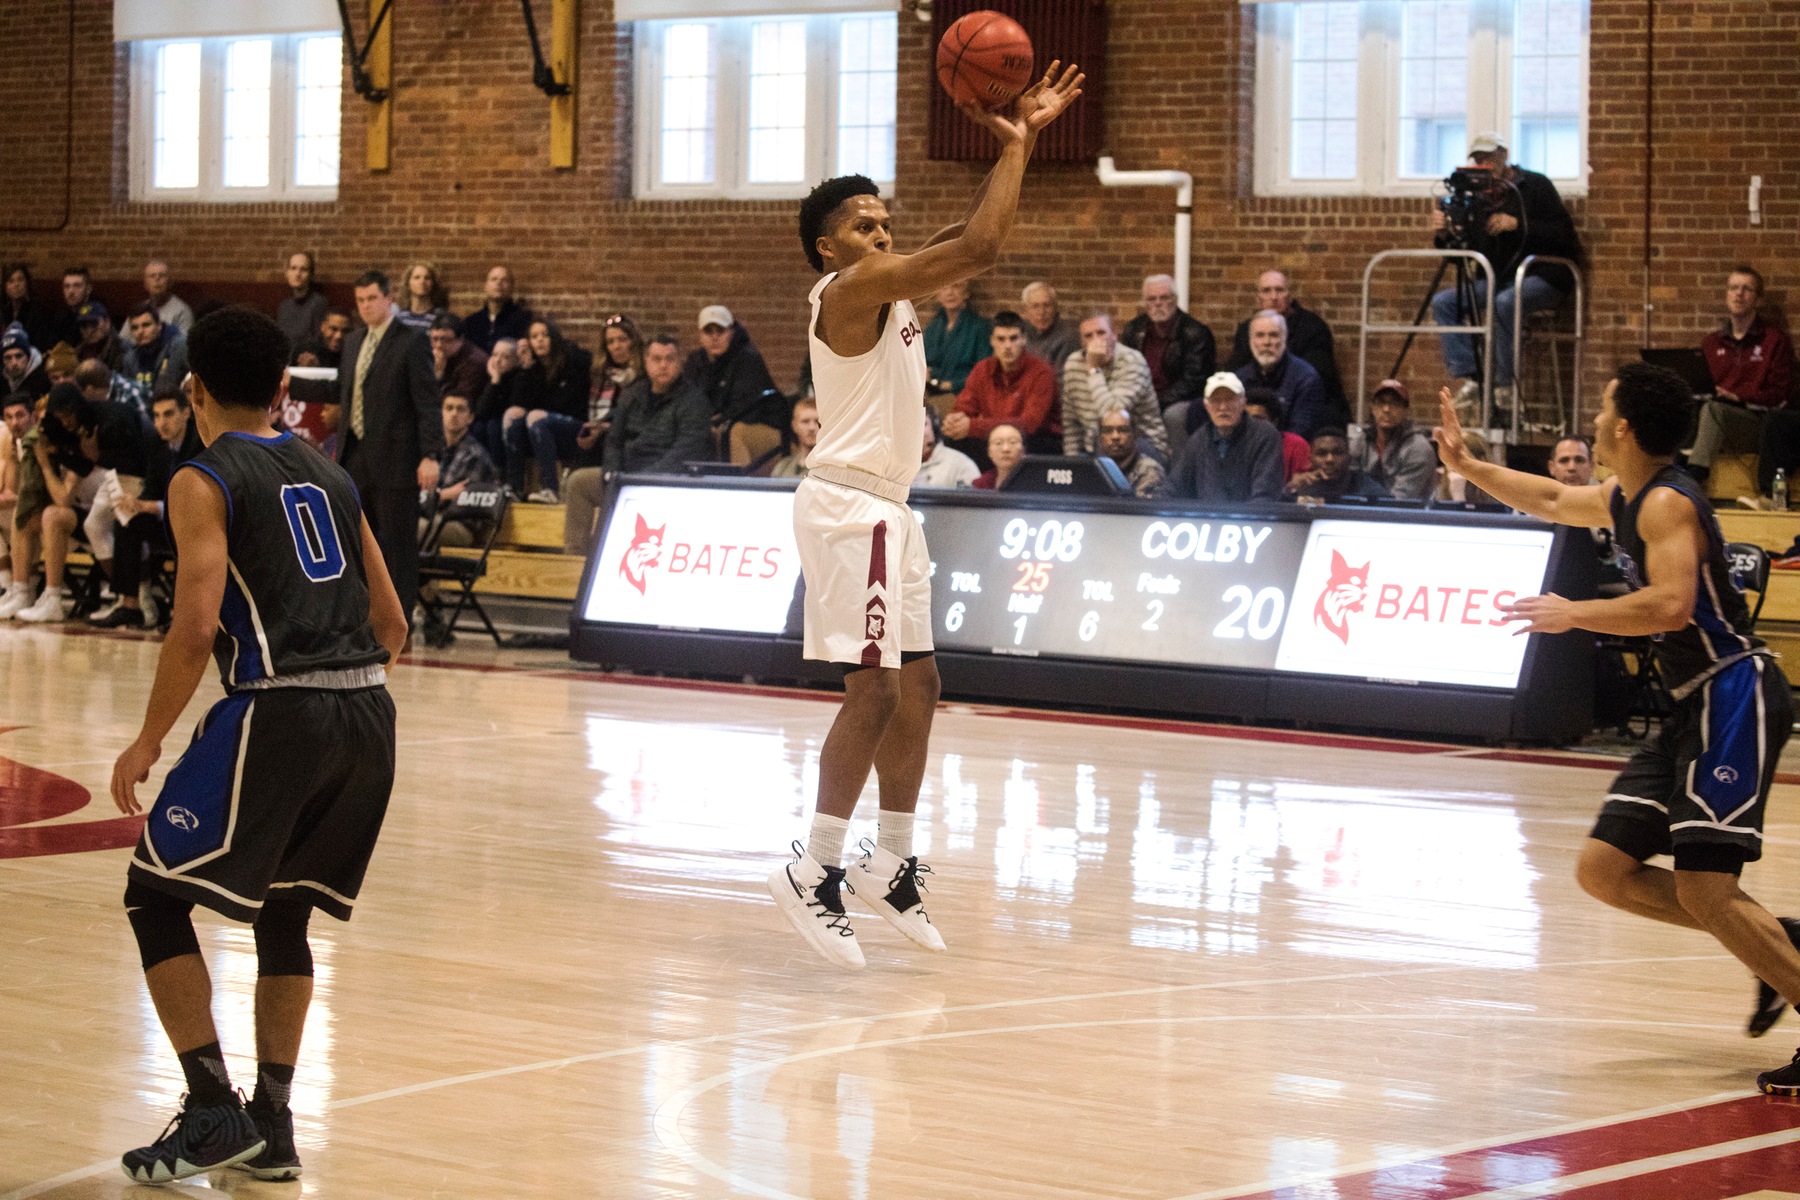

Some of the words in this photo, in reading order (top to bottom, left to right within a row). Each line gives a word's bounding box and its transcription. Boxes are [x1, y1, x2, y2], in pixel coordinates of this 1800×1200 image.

[1047, 469, 1073, 484] POSS
[457, 491, 498, 507] BATES
[280, 482, 347, 582] 0
[999, 518, 1084, 562] 9:08
[1141, 521, 1272, 563] COLBY
[667, 543, 781, 579] BATES
[951, 572, 982, 593] TOL
[1012, 561, 1053, 592] 25
[1082, 580, 1114, 602] TOL
[945, 602, 966, 632] 6
[1141, 600, 1164, 630] 2
[1213, 584, 1285, 640] 20
[1375, 584, 1516, 626] BATES
[1014, 615, 1027, 645] 1
[1079, 611, 1100, 641] 6
